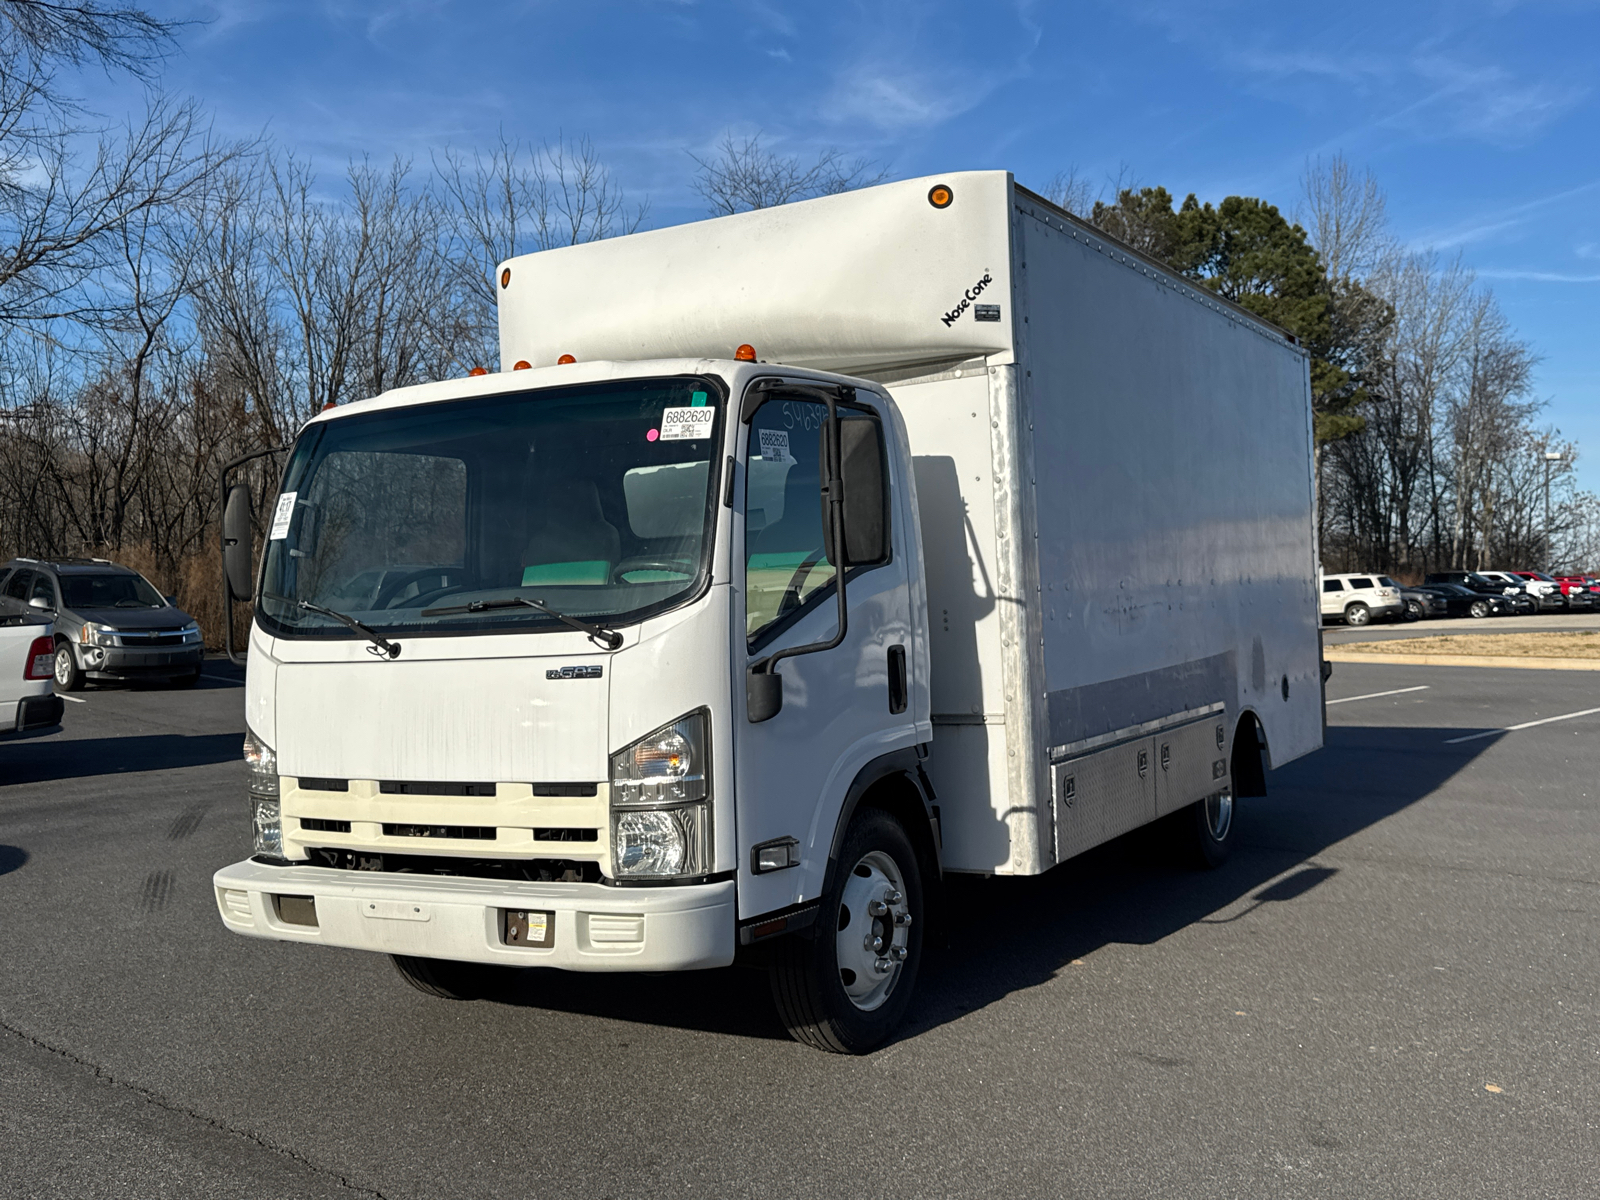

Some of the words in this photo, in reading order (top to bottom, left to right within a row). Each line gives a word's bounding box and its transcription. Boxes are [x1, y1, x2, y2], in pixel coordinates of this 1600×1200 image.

[941, 274, 993, 328] NoseCone
[666, 410, 711, 424] 6882620
[761, 432, 788, 447] 6882620
